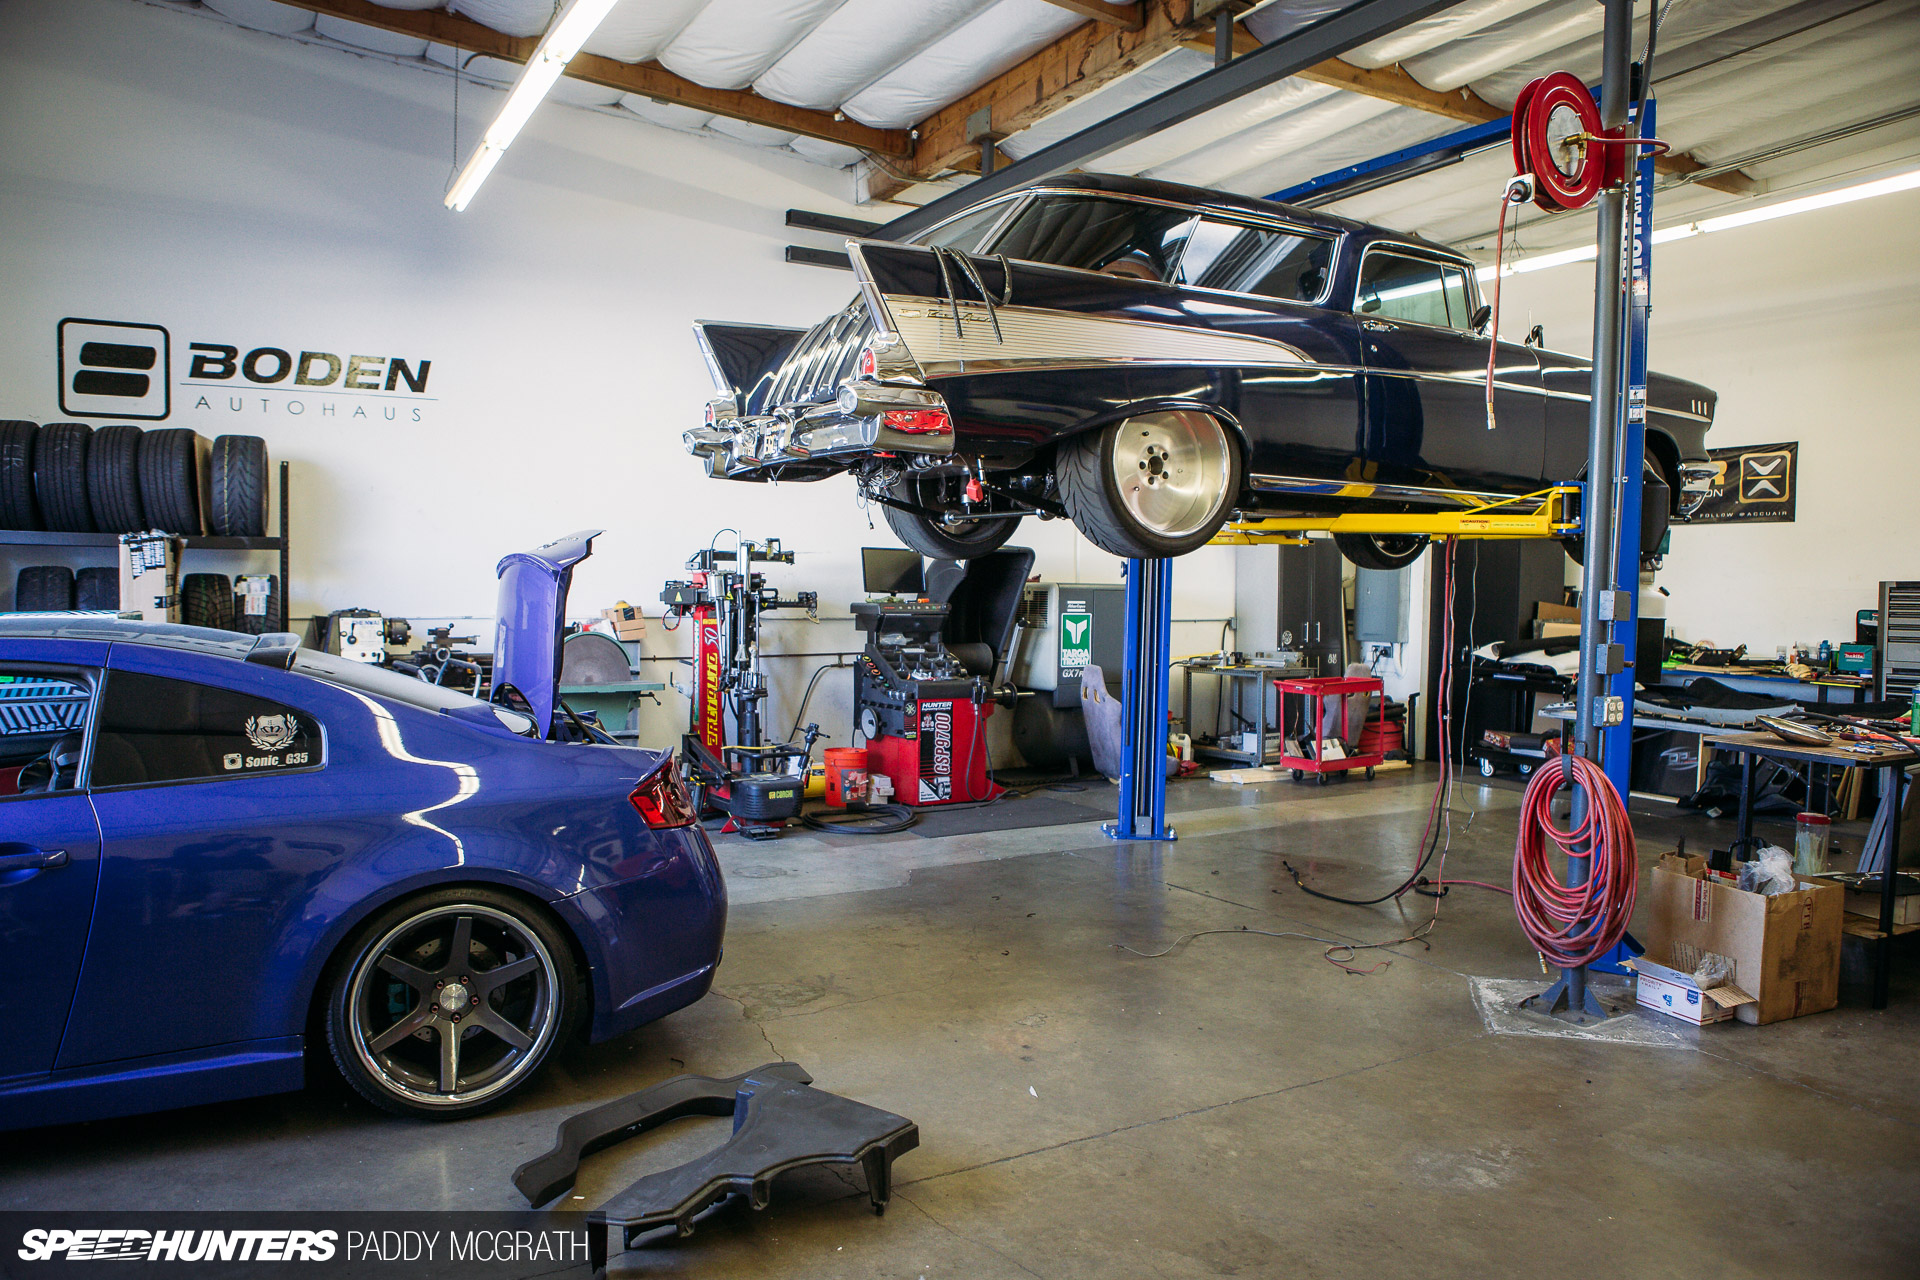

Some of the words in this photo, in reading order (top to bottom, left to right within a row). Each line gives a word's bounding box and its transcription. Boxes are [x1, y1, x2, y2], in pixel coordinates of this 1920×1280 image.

[189, 342, 432, 393] BODEN
[195, 396, 421, 422] AUTOHAUS
[704, 627, 719, 650] 50
[1062, 648, 1090, 658] TARGA
[1062, 658, 1090, 666] TROPHY
[922, 701, 953, 709] HUNTER
[934, 712, 952, 775] GSP9700
[245, 752, 309, 768] Sonic_G35
[1639, 976, 1663, 988] PRIORITY
